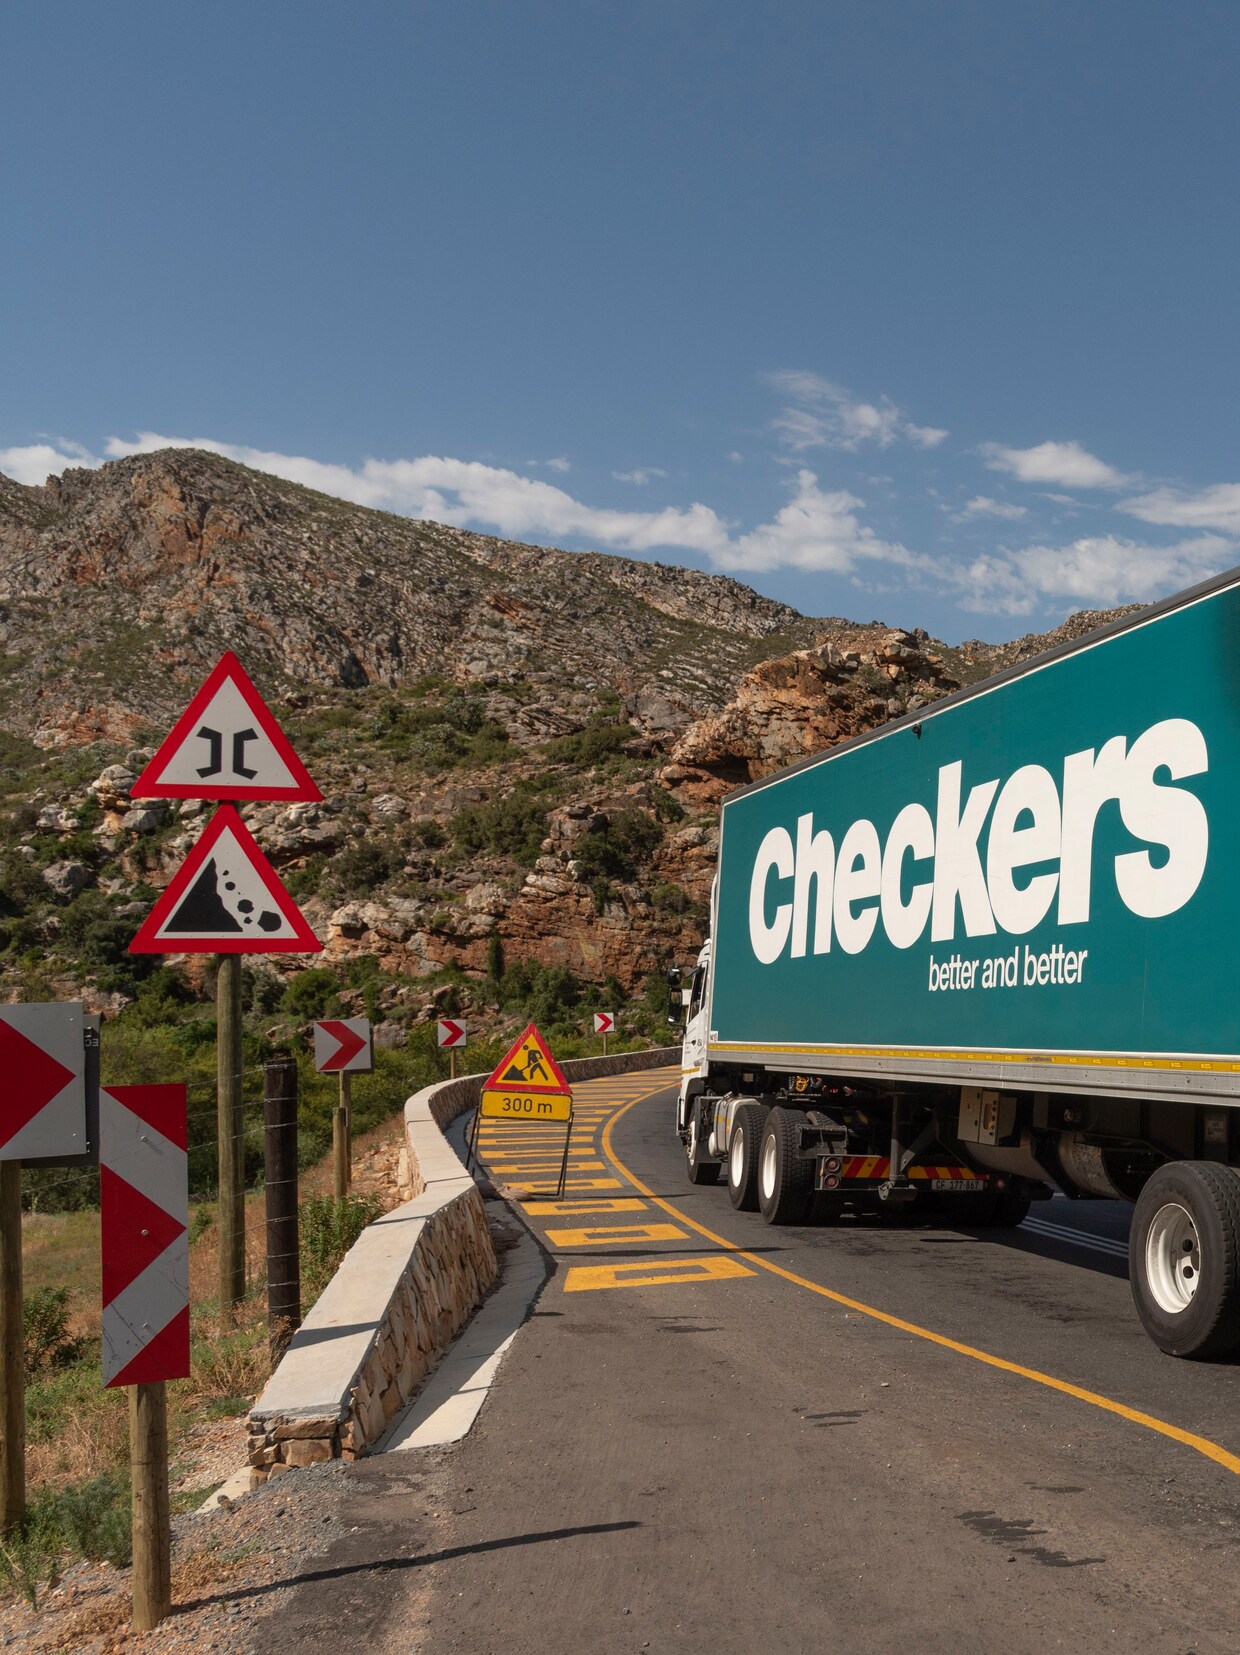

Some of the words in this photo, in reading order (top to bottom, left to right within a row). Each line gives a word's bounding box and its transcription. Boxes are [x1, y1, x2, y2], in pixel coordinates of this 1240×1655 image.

[748, 717, 1209, 965] checkers
[928, 954, 980, 992] better
[981, 945, 1020, 989] and
[1023, 943, 1088, 986] better
[502, 1097, 533, 1113] 300
[537, 1103, 553, 1114] m
